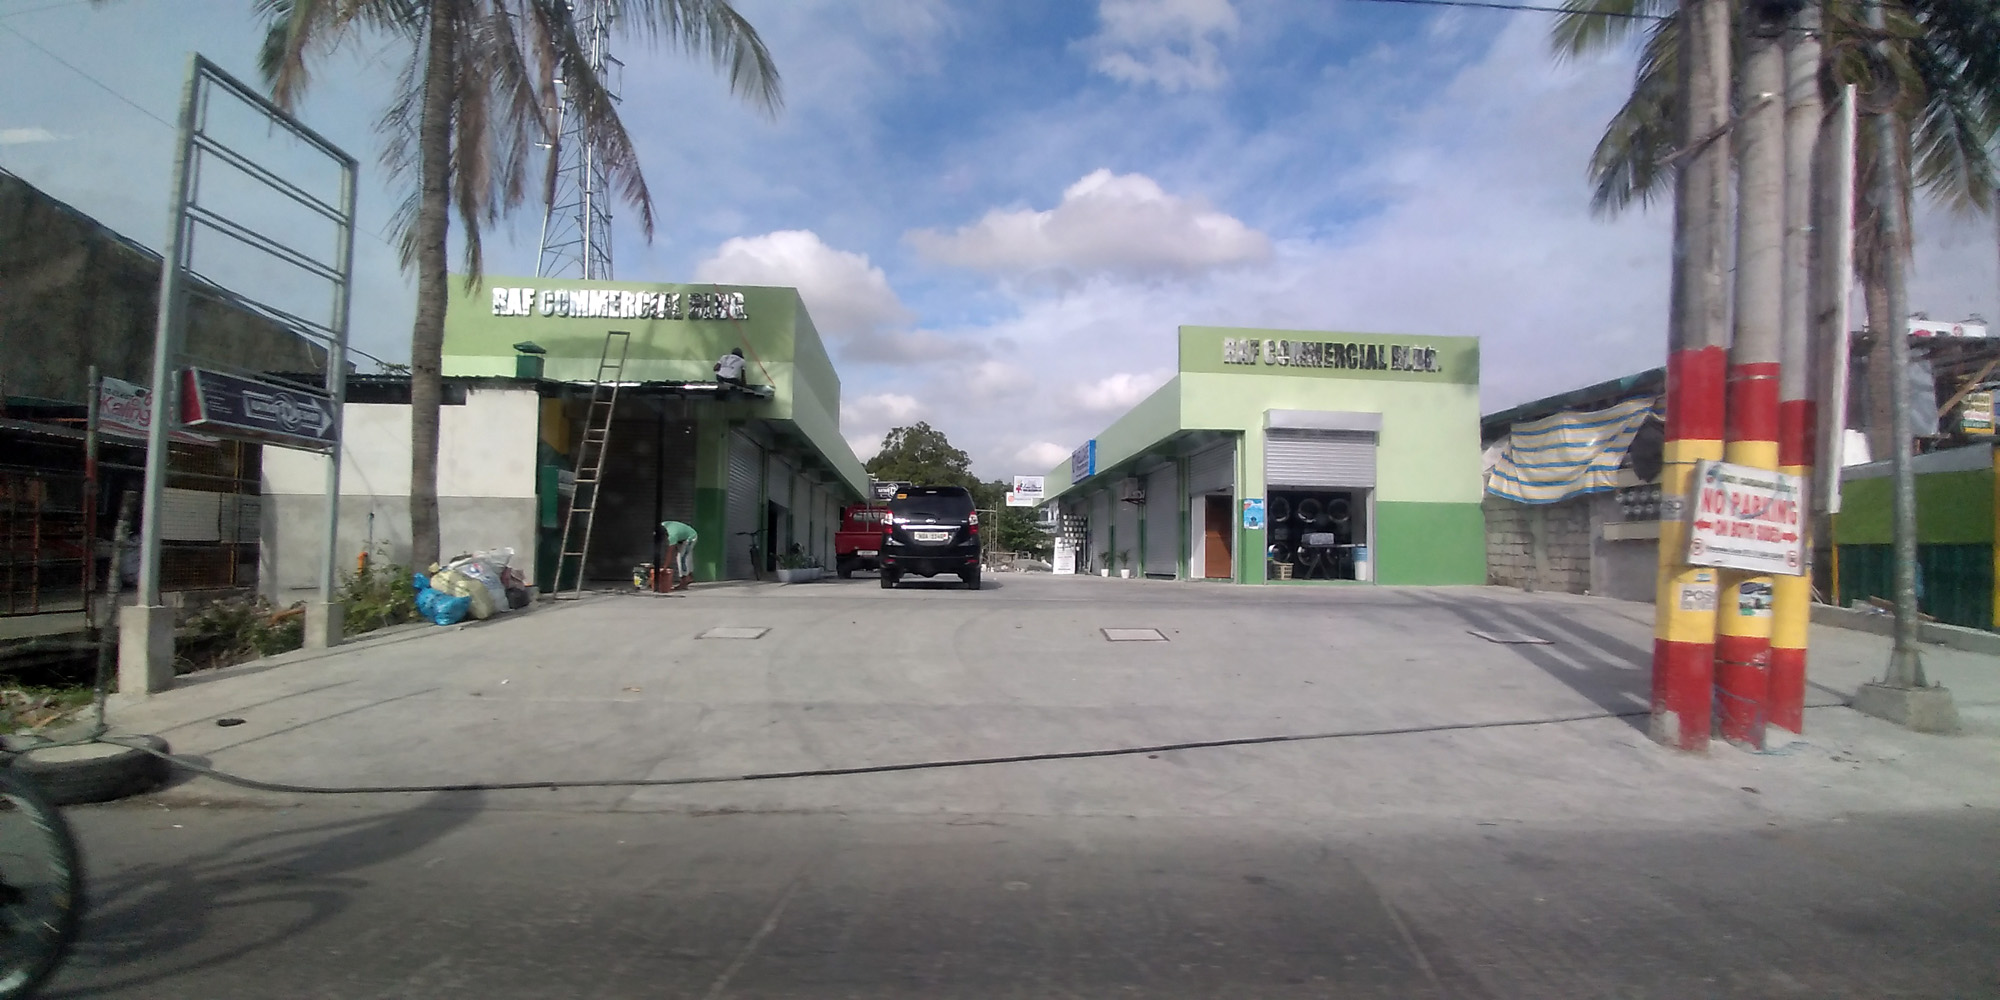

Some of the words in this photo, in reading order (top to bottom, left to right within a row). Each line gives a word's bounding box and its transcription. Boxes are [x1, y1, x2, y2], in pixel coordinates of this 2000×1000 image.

[492, 287, 536, 317] RAF
[538, 288, 684, 320] COMMERCIAL
[1223, 337, 1260, 366] RAF
[1263, 339, 1388, 371] COMMERCIAL
[1702, 487, 1726, 515] NO
[1731, 491, 1797, 525] PARKING
